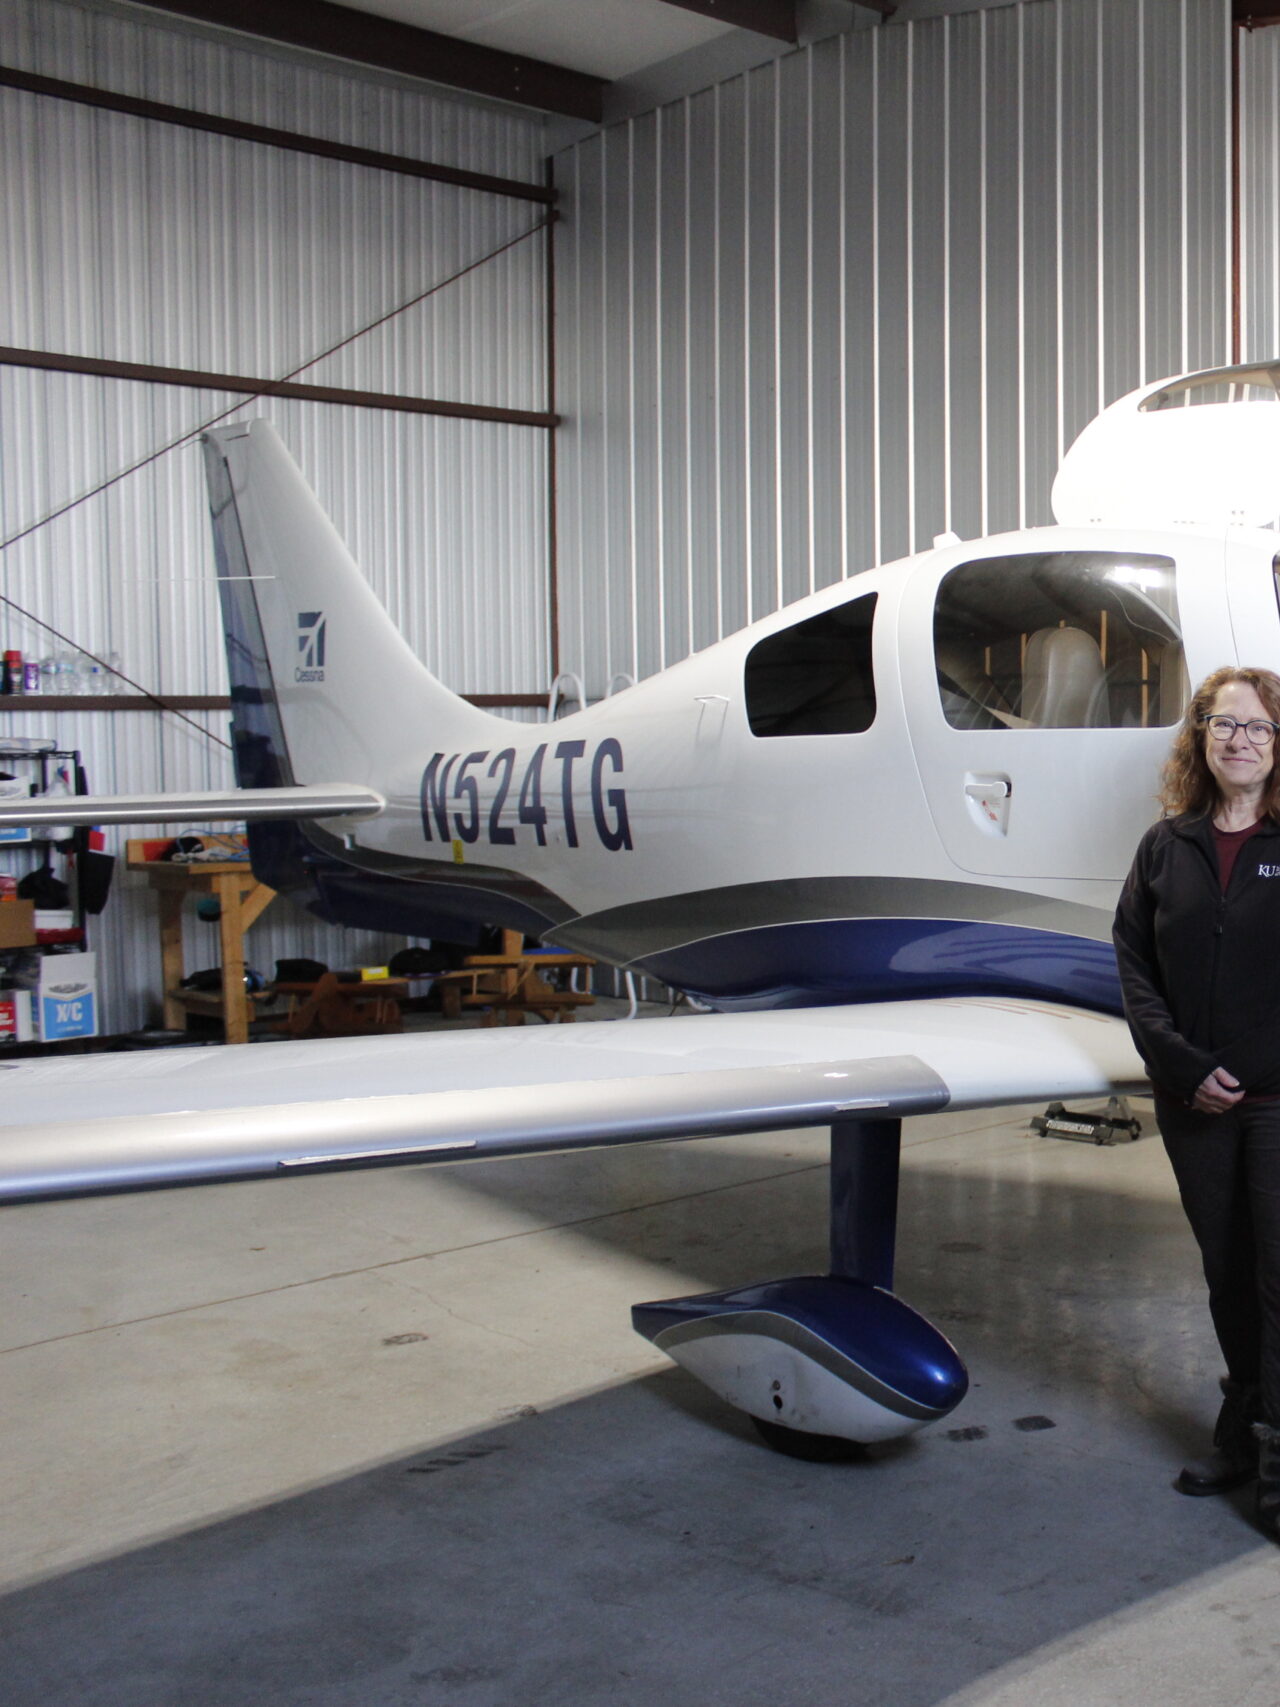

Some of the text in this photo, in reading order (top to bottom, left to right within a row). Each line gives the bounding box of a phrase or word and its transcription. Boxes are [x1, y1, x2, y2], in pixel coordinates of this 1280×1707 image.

[294, 667, 325, 682] Cessna
[420, 737, 633, 851] N524TG
[1258, 864, 1276, 878] KU
